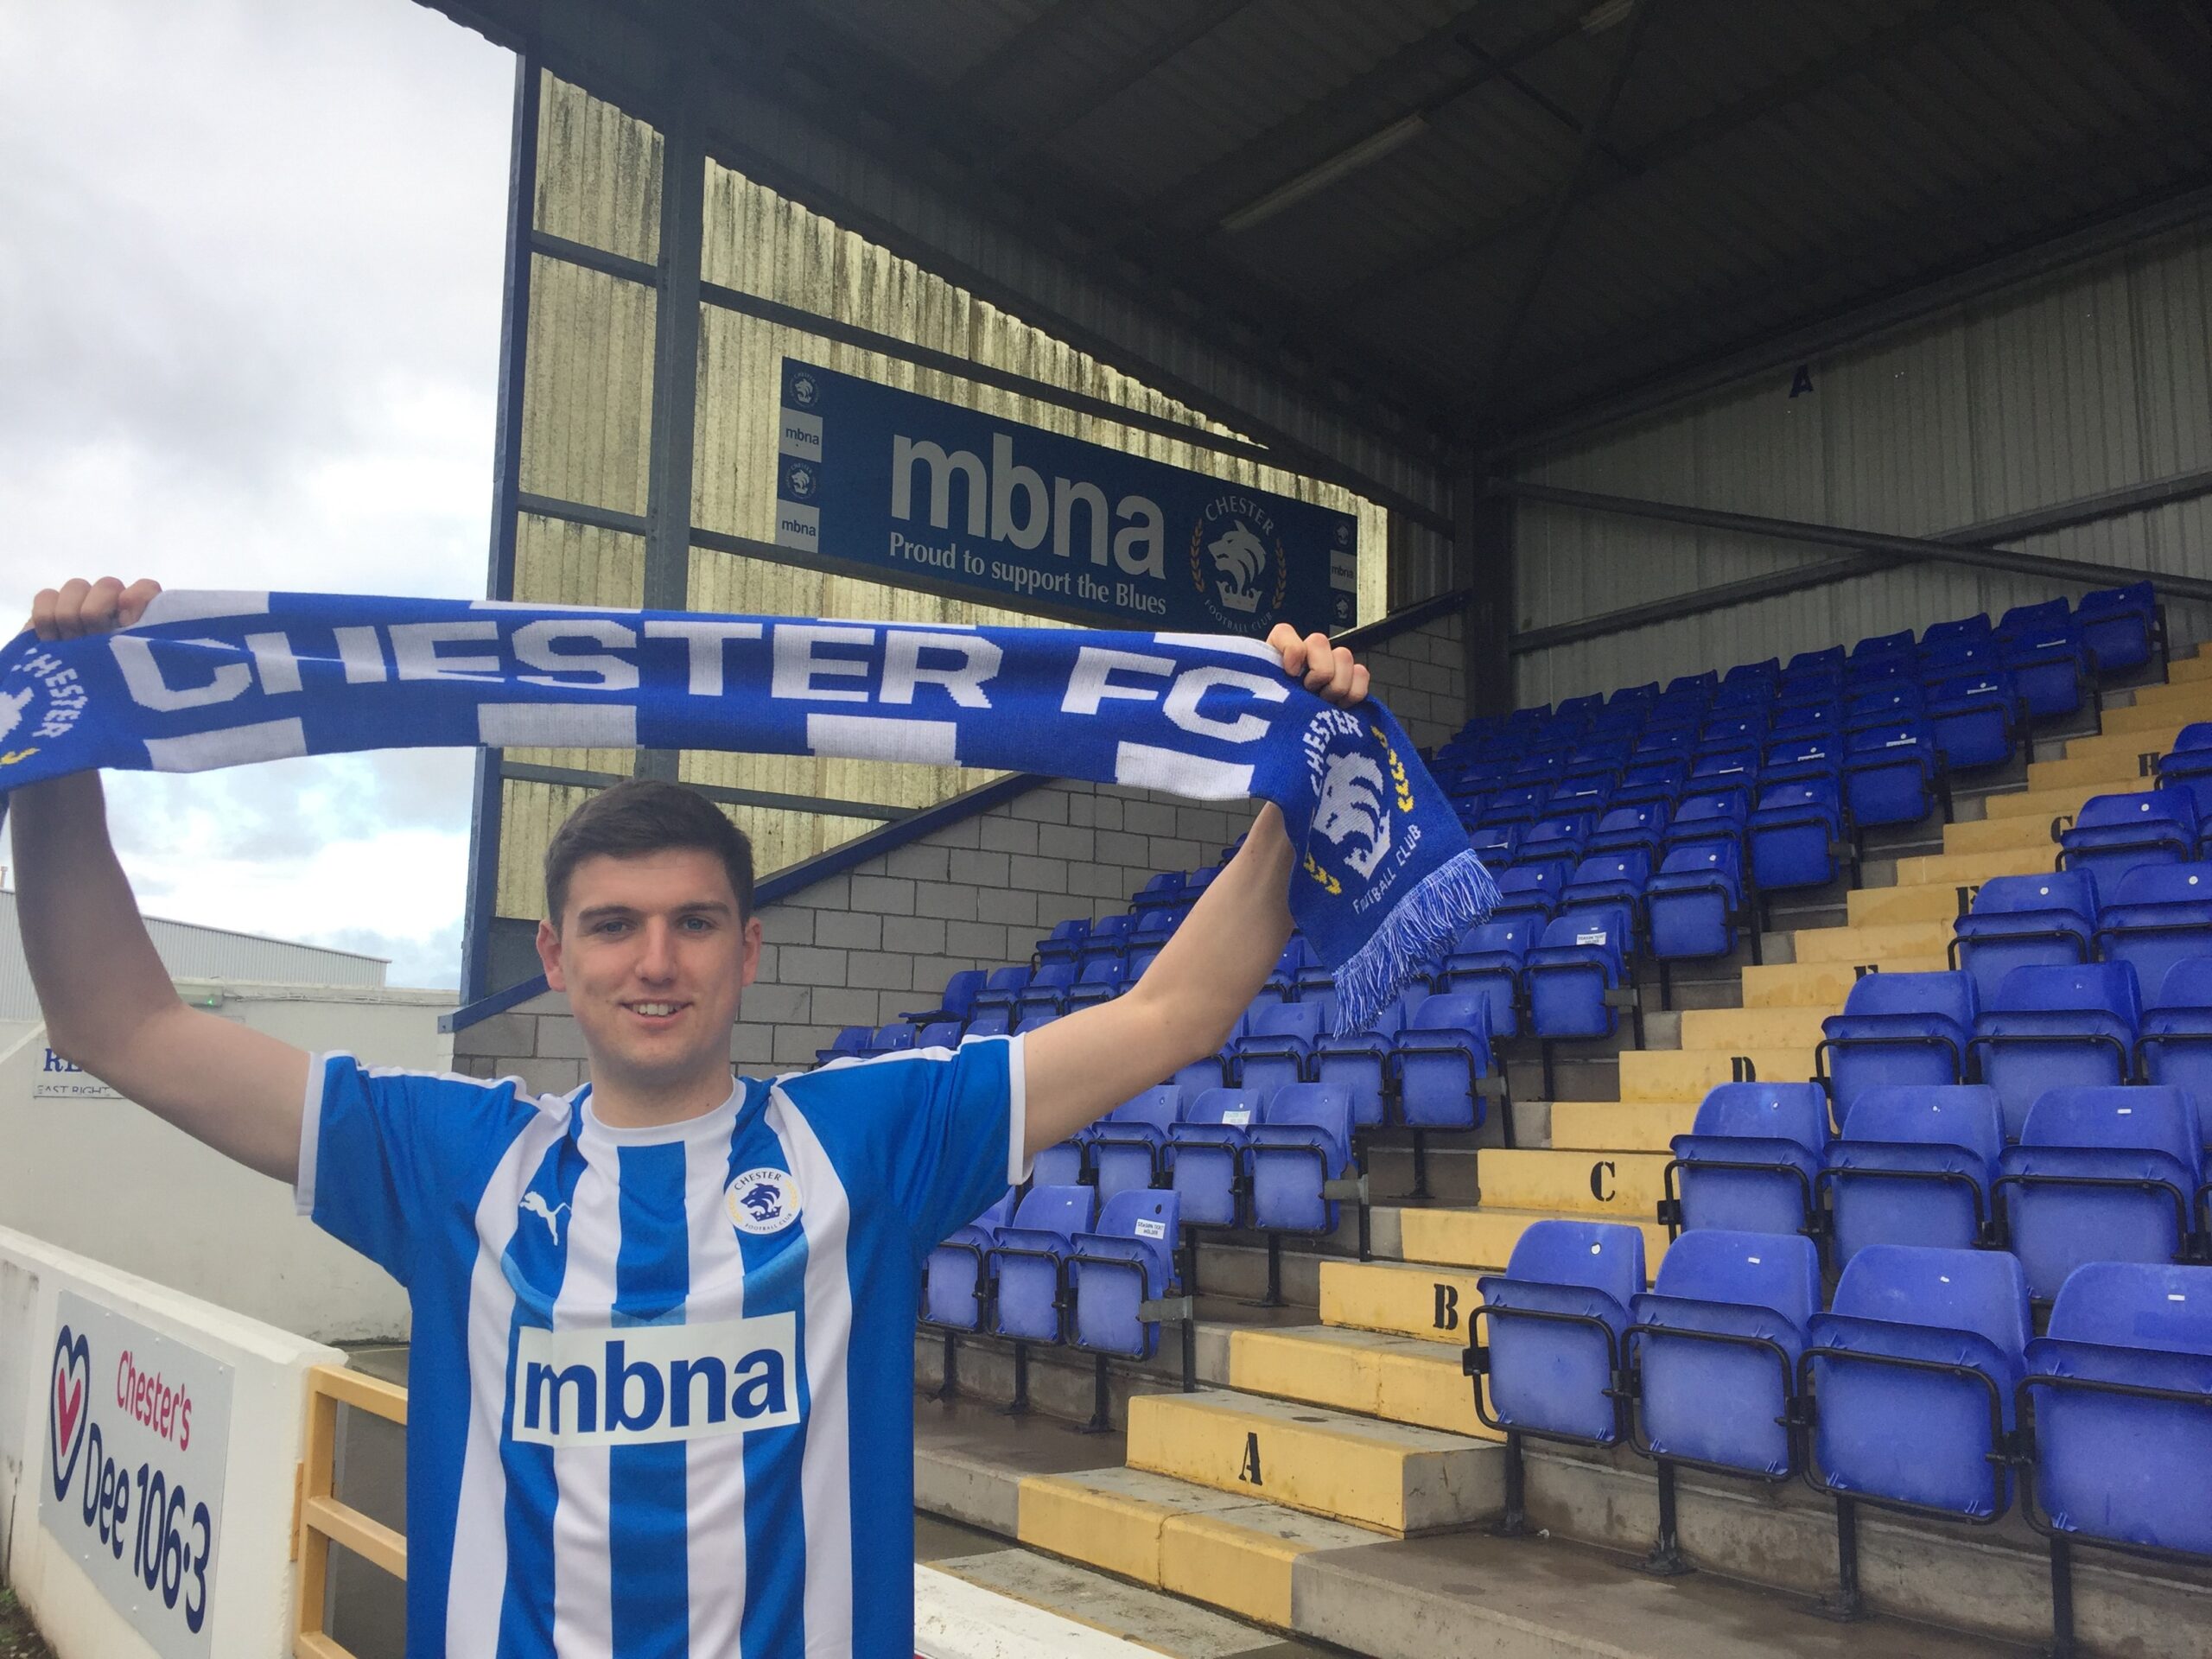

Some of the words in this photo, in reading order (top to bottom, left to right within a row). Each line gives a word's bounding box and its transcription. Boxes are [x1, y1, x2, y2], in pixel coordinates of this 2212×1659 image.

[1789, 364, 1814, 398] A
[785, 428, 820, 446] mbna
[781, 519, 817, 537] mbna
[891, 432, 1166, 580] mbna
[1205, 495, 1274, 537] CHESTER
[889, 531, 957, 569] Proud
[963, 550, 986, 575] to
[991, 561, 1071, 595] support
[1077, 573, 1109, 603] the
[1116, 582, 1166, 615] Blues
[1205, 599, 1249, 632] FOOTBALL
[1252, 612, 1273, 632] CLUB
[108, 618, 1004, 713] CHESTER
[1061, 646, 1290, 744] FC
[1395, 823, 1422, 867] CLUB
[734, 1171, 782, 1191] CHESTER
[1590, 1160, 1616, 1203] C
[779, 1212, 793, 1225] CLUB
[1433, 1283, 1459, 1331] B
[117, 1350, 192, 1452] Chester's
[524, 1340, 787, 1435] mbna
[1238, 1432, 1262, 1486] A
[83, 1422, 130, 1560] Dee
